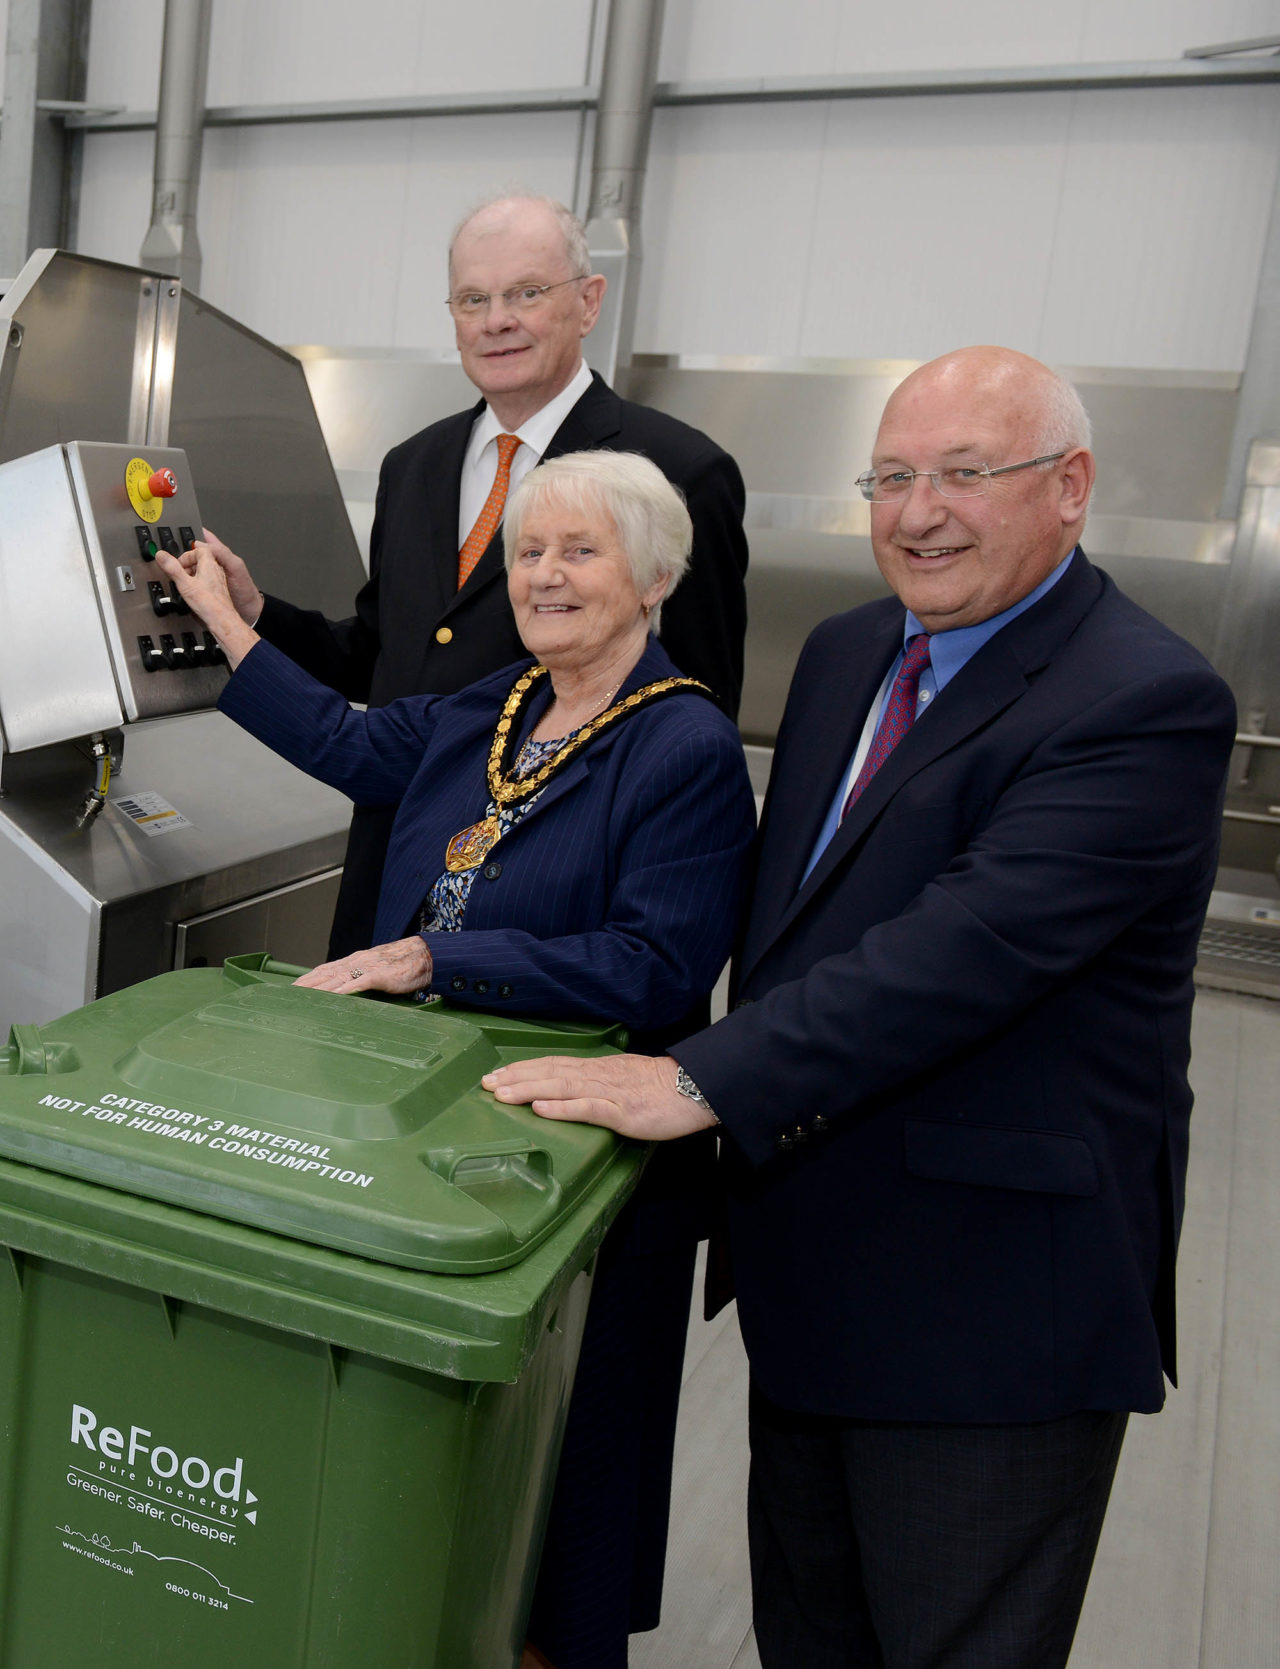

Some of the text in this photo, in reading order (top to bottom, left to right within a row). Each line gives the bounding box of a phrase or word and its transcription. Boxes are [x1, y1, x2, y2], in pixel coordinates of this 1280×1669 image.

[37, 1094, 375, 1189] NOT FOR HUMAN CONSUMPTION
[99, 1093, 332, 1161] CATEGORY 3 MATERIAL
[70, 1403, 243, 1502] ReFood
[66, 1472, 237, 1546] Greener. Safer. Cheaper.
[98, 1460, 239, 1518] pure bioenergy
[62, 1540, 134, 1576] www.refood.co.uk
[165, 1582, 229, 1611] 0800 011 3214
